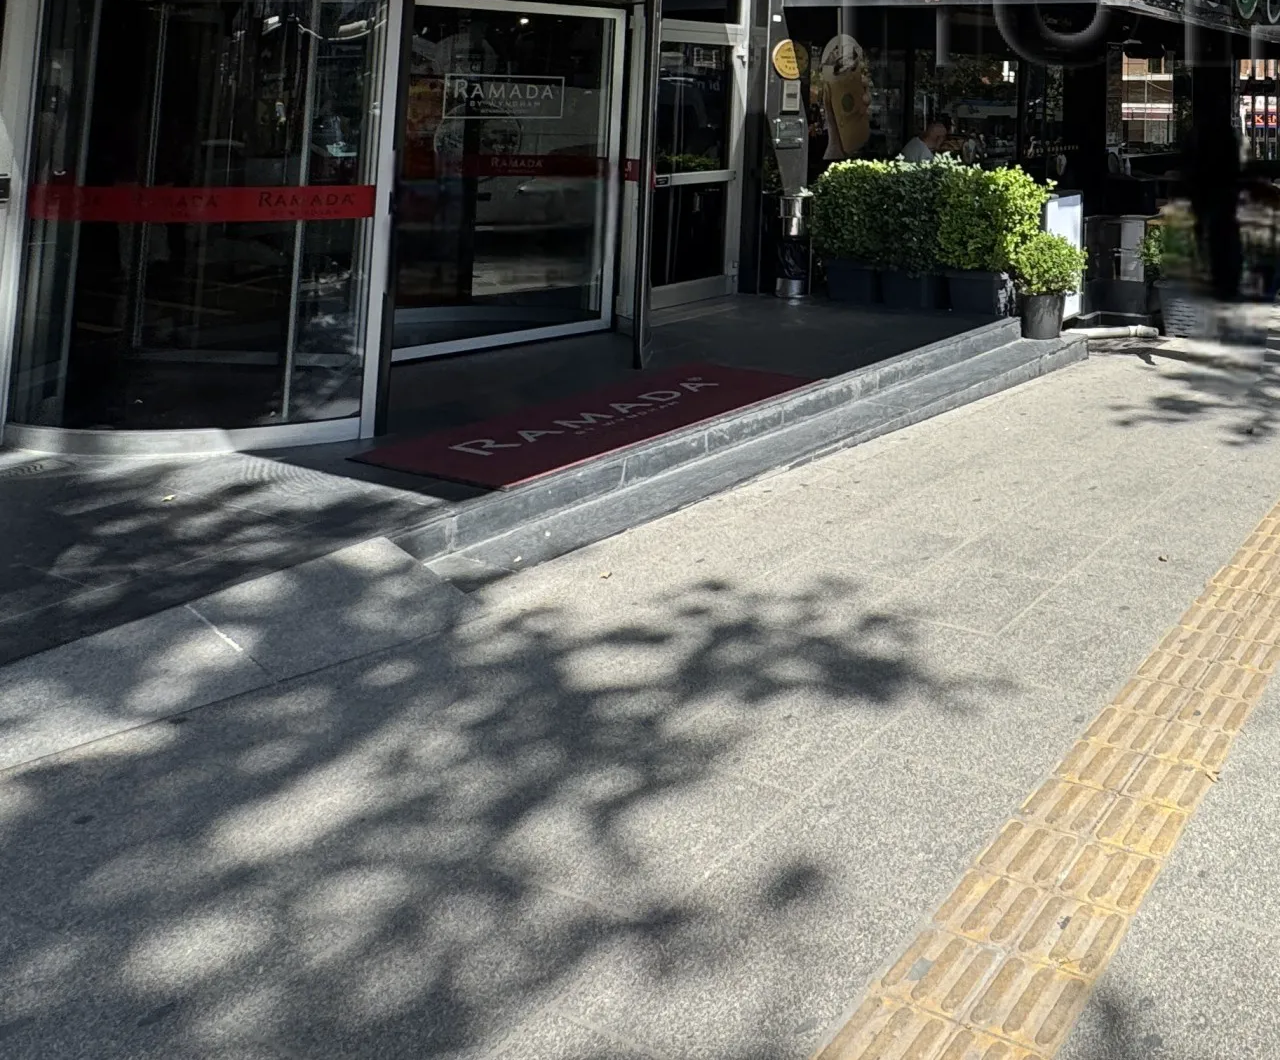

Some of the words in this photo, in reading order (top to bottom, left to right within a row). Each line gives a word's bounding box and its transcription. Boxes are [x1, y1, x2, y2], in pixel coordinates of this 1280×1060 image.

[453, 78, 554, 100] RAMADA
[491, 157, 543, 168] RAMADA
[448, 381, 720, 457] RAMADA
